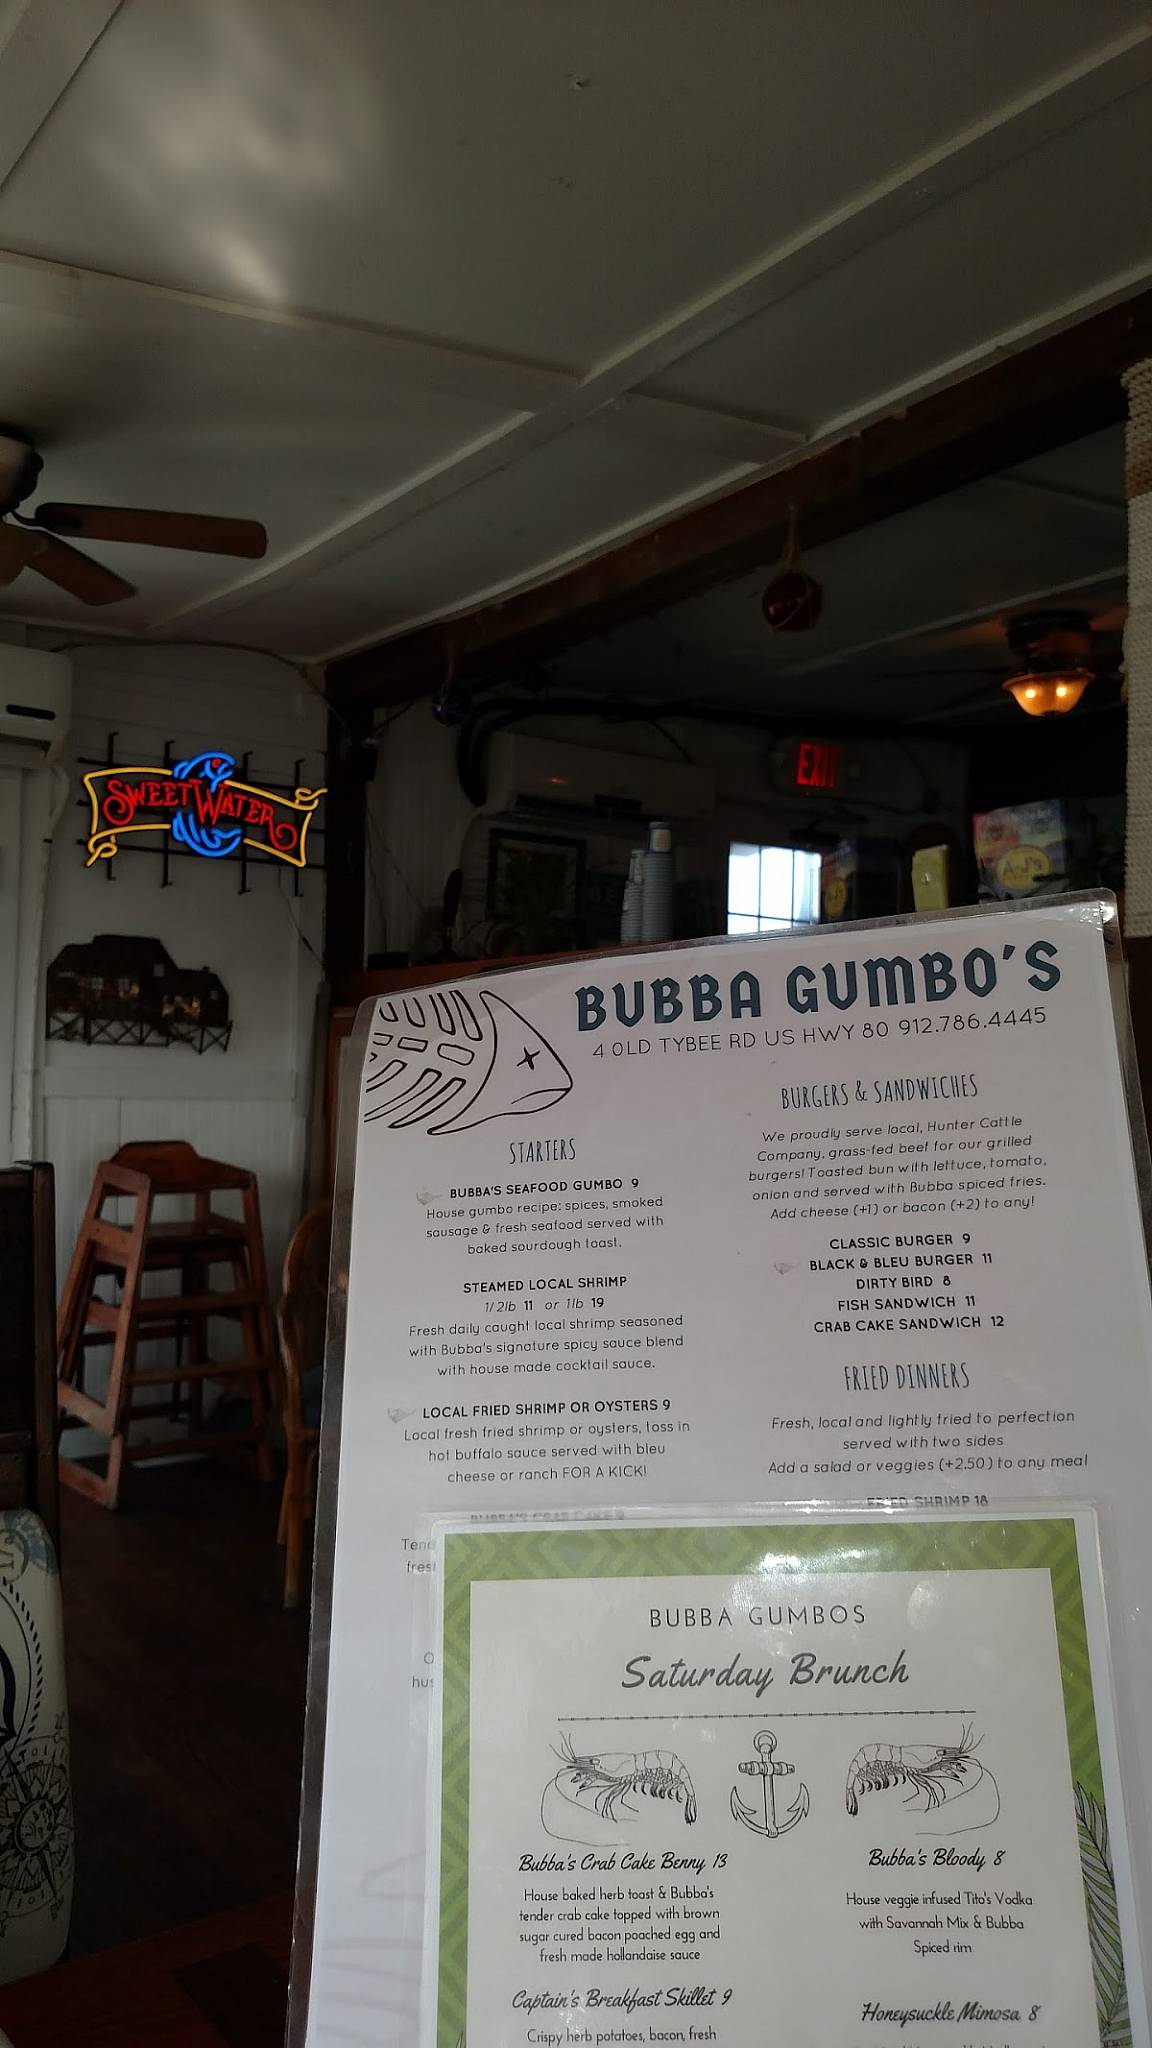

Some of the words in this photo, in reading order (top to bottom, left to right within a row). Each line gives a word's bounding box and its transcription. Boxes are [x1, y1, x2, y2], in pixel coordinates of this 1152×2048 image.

[797, 741, 840, 787] EXIT
[575, 971, 761, 1031] BUBBA
[787, 940, 1060, 1014] GUMBO'S
[593, 1044, 603, 1057] 4
[612, 1040, 650, 1056] OLD
[659, 1035, 721, 1052] TYBEE
[730, 1033, 755, 1048] RD
[765, 1029, 794, 1046] US
[803, 1025, 854, 1043] HWY
[863, 1022, 888, 1038] 80
[899, 1007, 1045, 1035] 912.786.4445
[782, 1084, 848, 1109] BURGERS
[856, 1081, 867, 1101] &
[874, 1074, 977, 1103] SANDWICHES
[510, 1138, 575, 1164] STARTERS
[451, 1186, 501, 1198] BUBBA'S
[506, 1182, 567, 1194] SEAFOOD
[573, 1179, 622, 1190] GUMBO
[632, 1179, 638, 1188] 9
[753, 1191, 788, 1200] onion
[794, 1187, 819, 1198] and
[824, 1185, 869, 1197] served
[875, 1183, 904, 1194] with
[910, 1181, 953, 1192] Bubba
[959, 1177, 1004, 1191] spiced
[1011, 1176, 1045, 1187] fries.
[427, 1227, 478, 1238] sausage
[483, 1224, 490, 1234] &
[496, 1222, 526, 1232] fresh
[532, 1219, 582, 1231] seafood
[587, 1217, 630, 1228] served
[636, 1216, 663, 1226] with
[468, 1242, 506, 1254] baked
[512, 1239, 580, 1251] sourdough
[586, 1238, 621, 1248] toast.
[830, 1237, 890, 1249] CLASSIC
[896, 1234, 952, 1246] BURGER
[963, 1234, 970, 1243] 9
[810, 1259, 855, 1270] BLACK
[860, 1258, 868, 1268] &
[874, 1257, 908, 1268] BLEU
[915, 1254, 973, 1266] BURGER
[982, 1253, 991, 1263] 11
[464, 1281, 523, 1293] STEAMED
[530, 1279, 573, 1290] LOCAL
[578, 1276, 626, 1288] SHRIMP
[857, 1278, 896, 1289] DIRTY
[902, 1276, 932, 1287] BIRD
[943, 1276, 951, 1286] 8
[524, 1300, 532, 1310] 11
[545, 1302, 559, 1310] or
[592, 1298, 604, 1307] 19
[838, 1300, 869, 1311] FISH
[875, 1296, 955, 1309] SANDWICH
[965, 1296, 975, 1306] 11
[814, 1321, 851, 1332] CRAB
[856, 1320, 894, 1331] CAKE
[899, 1316, 980, 1329] SANDWICH
[991, 1316, 1004, 1326] 12
[410, 1345, 436, 1356] with
[442, 1342, 492, 1355] Bubba's
[497, 1341, 559, 1355] signature
[564, 1339, 597, 1352] spicy
[603, 1340, 641, 1348] sauce
[647, 1336, 683, 1346] blend
[845, 1365, 888, 1390] FRIED
[896, 1363, 969, 1389] DINNERS
[424, 1406, 468, 1418] LOCAL
[473, 1405, 510, 1416] FRIED
[516, 1403, 565, 1415] SHRIMP
[571, 1402, 589, 1413] OR
[595, 1399, 658, 1412] OYSTERS
[663, 1400, 670, 1410] 9
[405, 1429, 439, 1440] Local
[445, 1427, 477, 1439] fresh
[483, 1426, 513, 1438] fried
[519, 1425, 565, 1438] shrimp
[570, 1426, 582, 1434] or
[589, 1423, 641, 1436] oysters,
[647, 1421, 673, 1432] toss
[679, 1422, 689, 1431] in
[448, 1471, 495, 1482] cheese
[501, 1472, 513, 1480] or
[520, 1468, 557, 1480] ranch
[563, 1466, 590, 1478] FOR
[596, 1466, 604, 1477] A
[609, 1465, 646, 1477] KICK!
[914, 1496, 969, 1507] SHRIMP
[974, 1495, 988, 1506] 18
[651, 1608, 732, 1627] BUBBA
[749, 1605, 864, 1625] GUMBOS
[622, 1653, 774, 1698] Saturday
[790, 1649, 909, 1685] Brunch
[519, 1853, 576, 1871] Bubba's
[581, 1852, 616, 1870] Crab
[621, 1852, 655, 1870] Cake
[661, 1852, 706, 1875] Benny
[713, 1853, 728, 1868] 13
[869, 1848, 927, 1866] Bubba's
[932, 1848, 985, 1872] Bloody
[994, 1850, 1006, 1865] 8
[525, 1889, 558, 1901] House
[563, 1887, 595, 1900] baked
[600, 1886, 624, 1900] herb
[628, 1888, 654, 1899] toast
[658, 1886, 666, 1899] &
[671, 1885, 713, 1899] Bubba's
[847, 1892, 880, 1905] House
[885, 1894, 919, 1908] veggie
[923, 1891, 960, 1904] infused
[964, 1892, 991, 1904] Tito's
[995, 1892, 1032, 1905] Vodka
[859, 1915, 883, 1928] with
[887, 1915, 943, 1928] Savannah
[947, 1916, 969, 1928] Mix
[974, 1915, 981, 1928] &
[986, 1915, 1024, 1929] Bubba
[520, 1934, 549, 1945] sugar
[554, 1927, 583, 1941] cured
[588, 1927, 621, 1941] bacon
[625, 1926, 670, 1944] poached
[675, 1932, 695, 1943] egg
[700, 1925, 720, 1939] and
[540, 1948, 566, 1961] fresh
[571, 1947, 602, 1961] made
[607, 1947, 666, 1960] hollandaise
[671, 1952, 700, 1960] sauce
[914, 1939, 949, 1957] Spiced
[954, 1942, 972, 1952] rim
[512, 1990, 579, 2015] Captain's
[585, 1988, 662, 2014] Breakfast
[664, 1987, 717, 2006] Skillet
[722, 1989, 733, 2005] 9
[862, 2001, 955, 2028] Honeysuckle
[957, 2001, 1021, 2022] Mimosa
[1029, 2005, 1041, 2021] 8
[528, 2029, 563, 2047] Crispy
[567, 2028, 592, 2042] herb
[597, 2029, 645, 2046] potatoes,
[650, 2027, 685, 2041] bacon,
[689, 2026, 716, 2040] fresh
